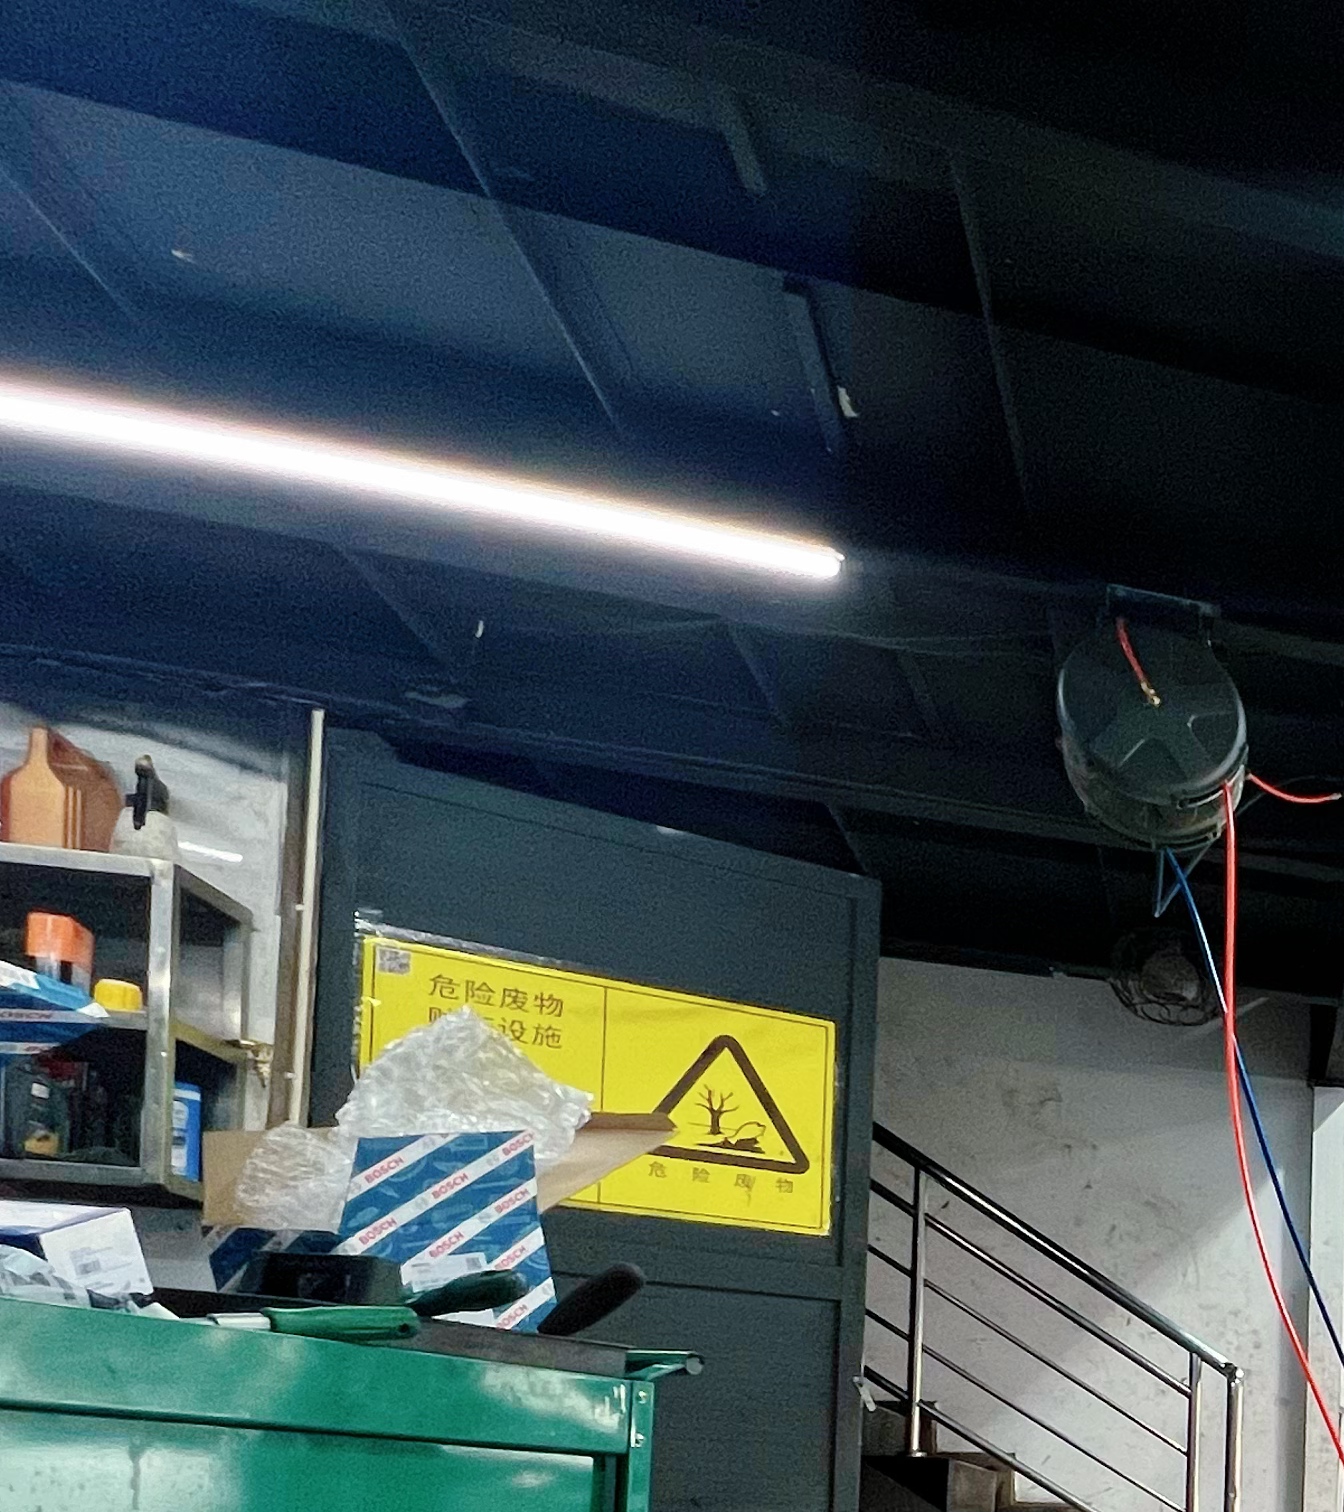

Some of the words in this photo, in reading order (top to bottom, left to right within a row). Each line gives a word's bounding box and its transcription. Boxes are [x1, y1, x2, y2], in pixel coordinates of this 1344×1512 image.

[428, 974, 564, 1018] 危险废物
[429, 1007, 562, 1049] 设施
[364, 1157, 404, 1184] BOSCH
[431, 1173, 469, 1199] BOSCH
[494, 1189, 529, 1213] BOSCH
[358, 1218, 397, 1245] BOSCH
[429, 1231, 465, 1258] BOSCH
